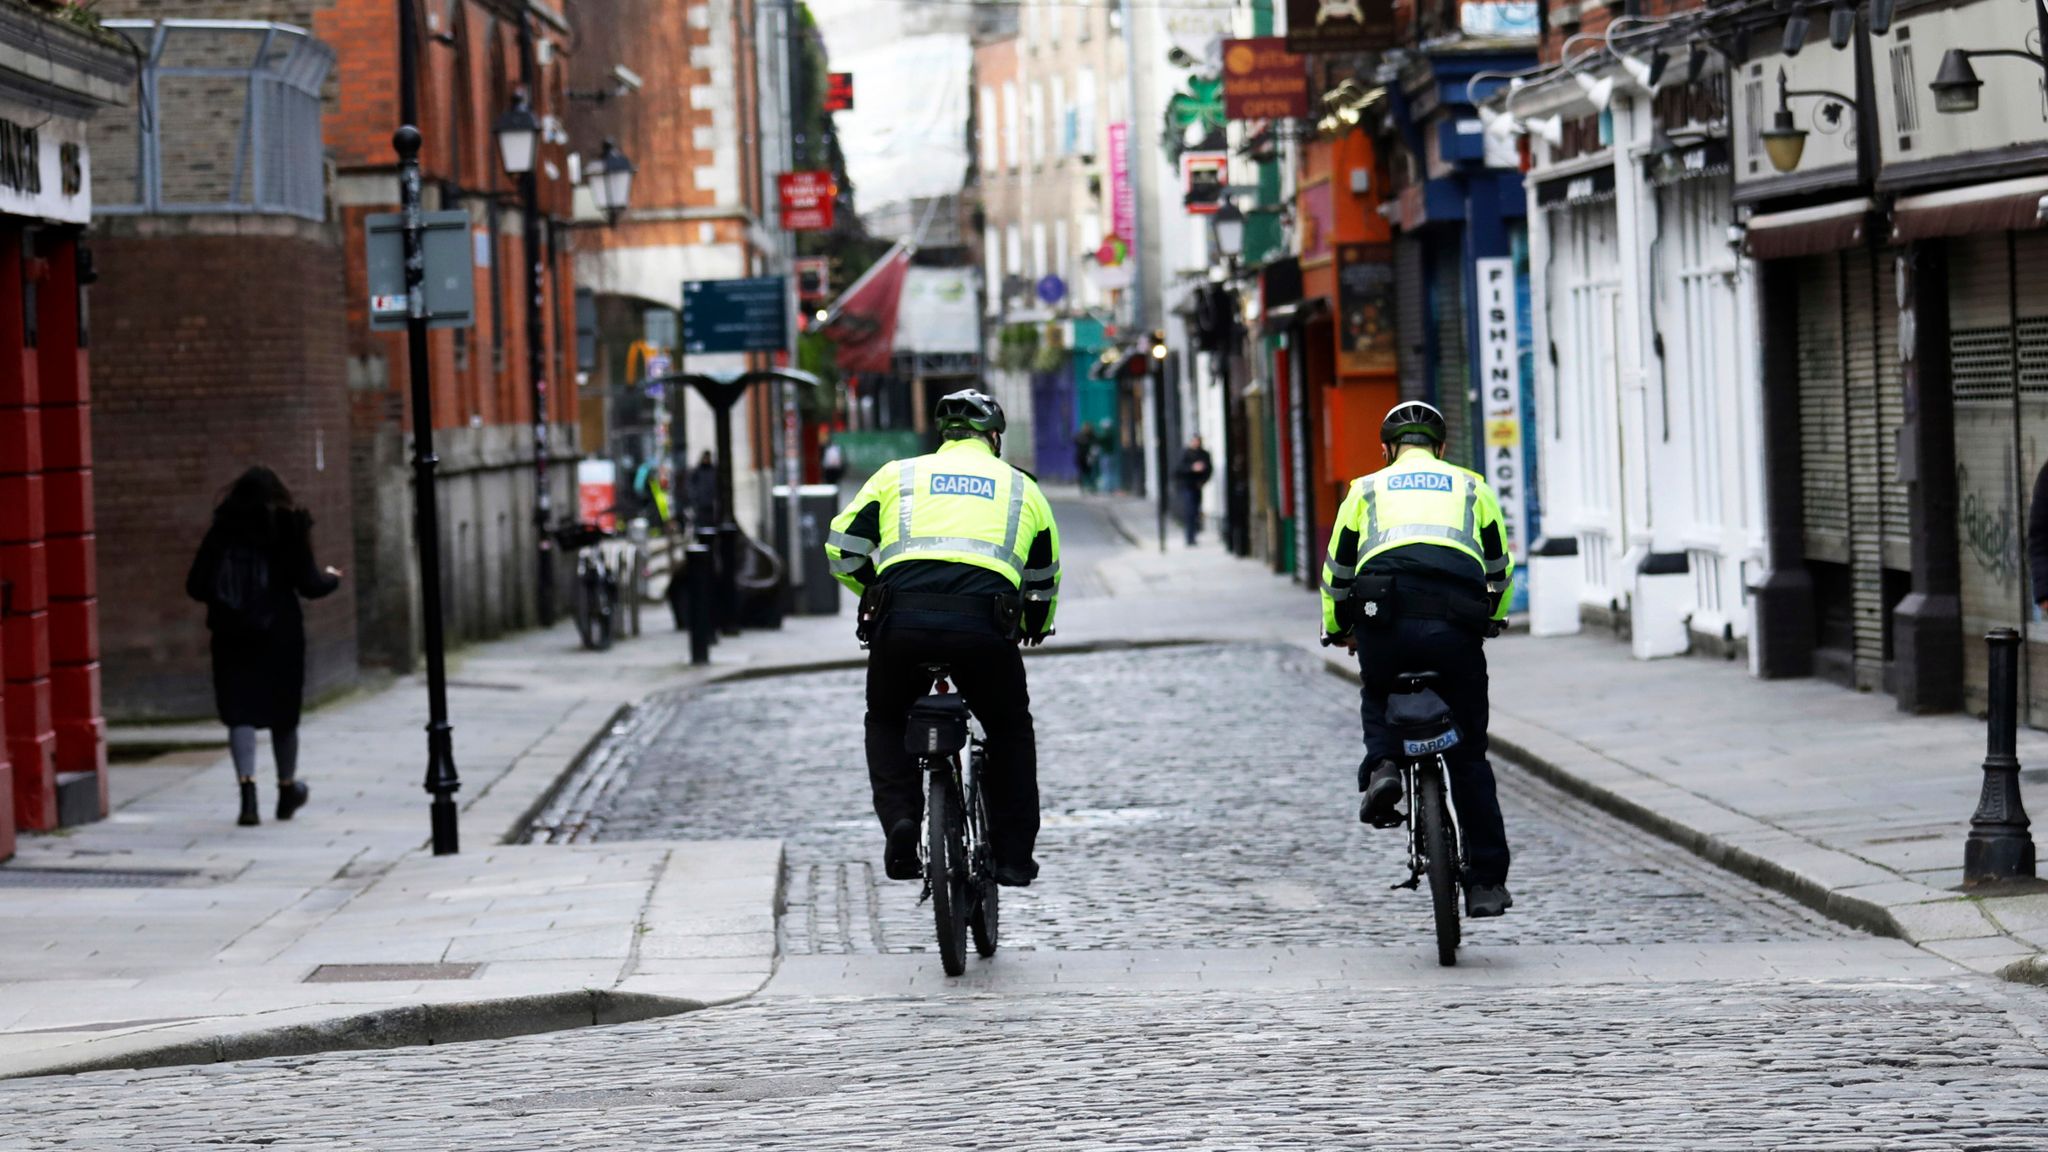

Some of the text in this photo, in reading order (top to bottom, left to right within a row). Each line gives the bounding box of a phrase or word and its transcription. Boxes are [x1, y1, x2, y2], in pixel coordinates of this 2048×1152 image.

[1489, 269, 1509, 401] FISHING
[932, 475, 994, 497] GARDA
[1388, 474, 1451, 491] GARDA
[1496, 447, 1515, 540] ACKLE
[1408, 732, 1454, 753] GARDA
